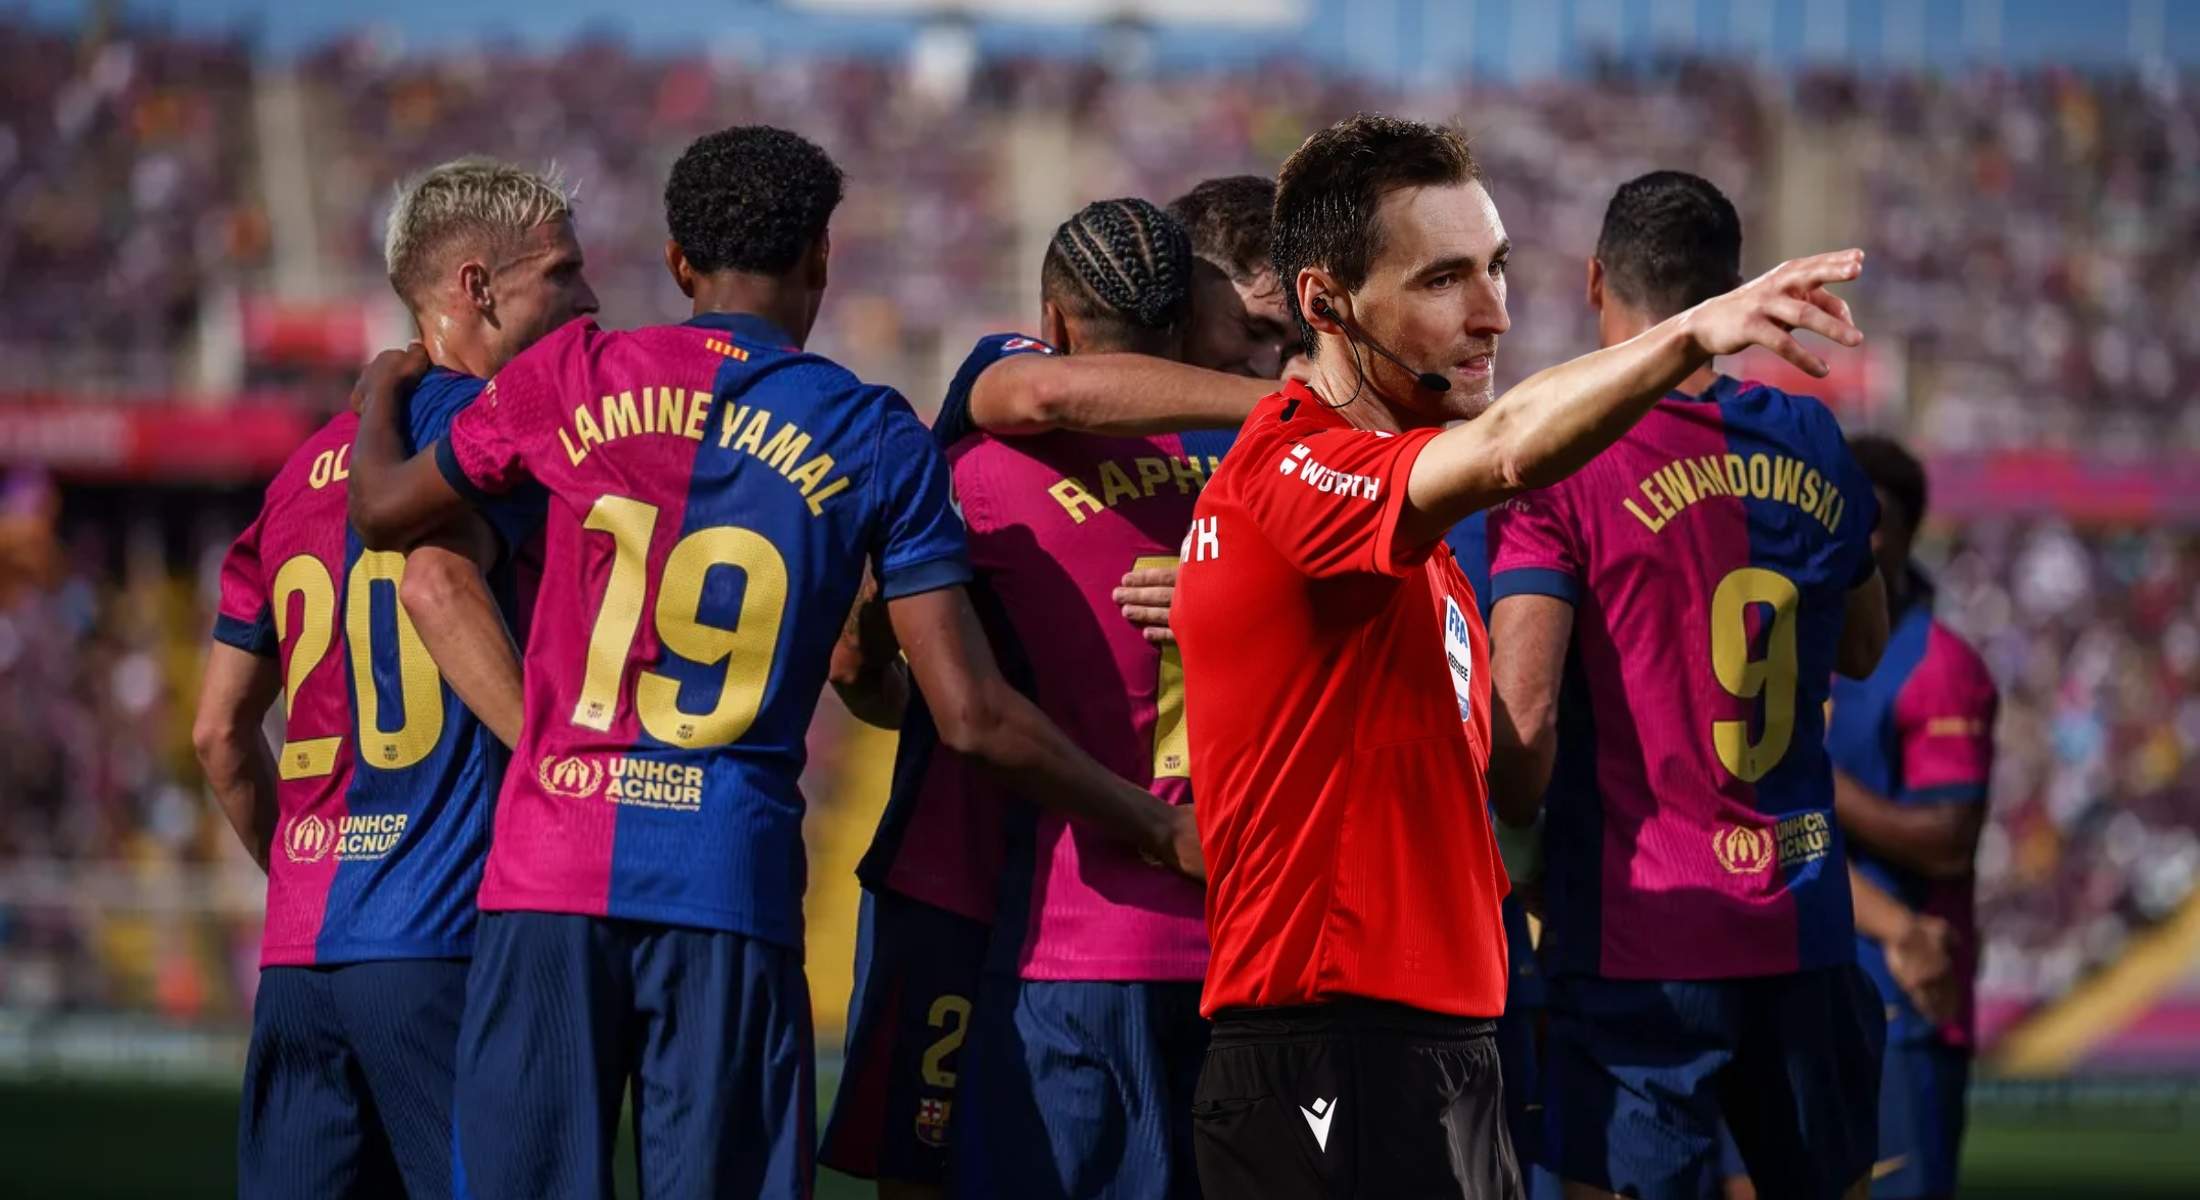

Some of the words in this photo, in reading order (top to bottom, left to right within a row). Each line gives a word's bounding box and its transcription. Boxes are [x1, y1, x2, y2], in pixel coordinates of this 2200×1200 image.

[558, 386, 713, 467] LAMINE
[720, 401, 850, 517] YAMAL
[1300, 457, 1380, 502] WÜRTH
[1623, 452, 1845, 534] LEWANDOWSKI
[571, 494, 789, 749] 19
[272, 550, 444, 780] 20
[1711, 566, 1799, 783] 9
[604, 778, 702, 804] ACNUR
[609, 757, 703, 787] UNHCR
[334, 832, 401, 854] ACNUR
[338, 813, 408, 834] UNHCR
[922, 994, 972, 1088] 2
